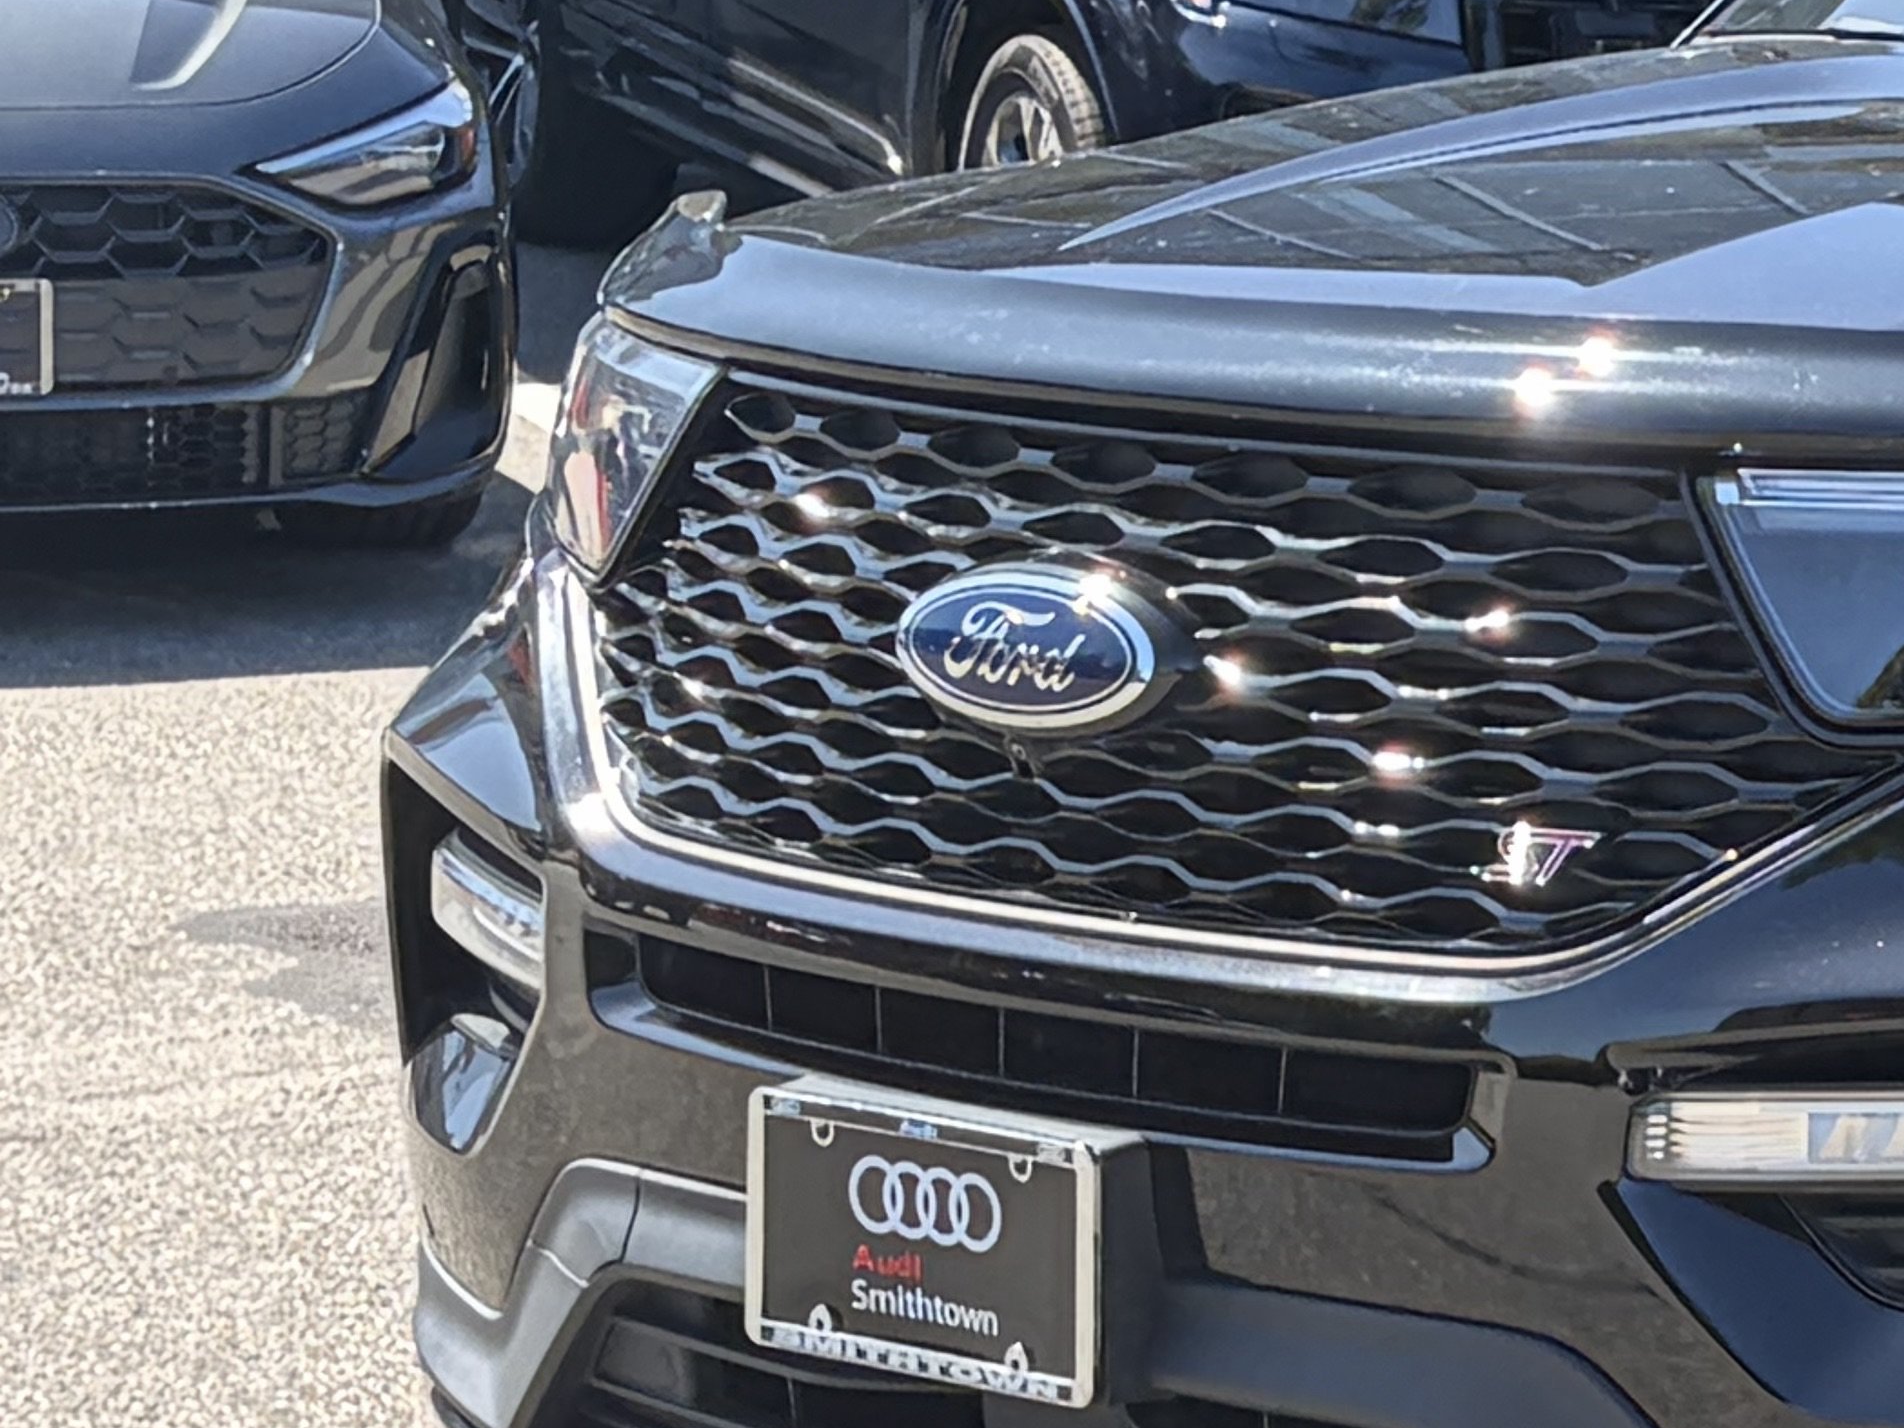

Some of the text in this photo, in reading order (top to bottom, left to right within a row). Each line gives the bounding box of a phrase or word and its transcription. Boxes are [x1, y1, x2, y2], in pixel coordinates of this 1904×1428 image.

[943, 600, 1085, 692] Ford
[1480, 821, 1603, 887] ST
[853, 1243, 923, 1283] Audi
[851, 1278, 999, 1336] Smithtown
